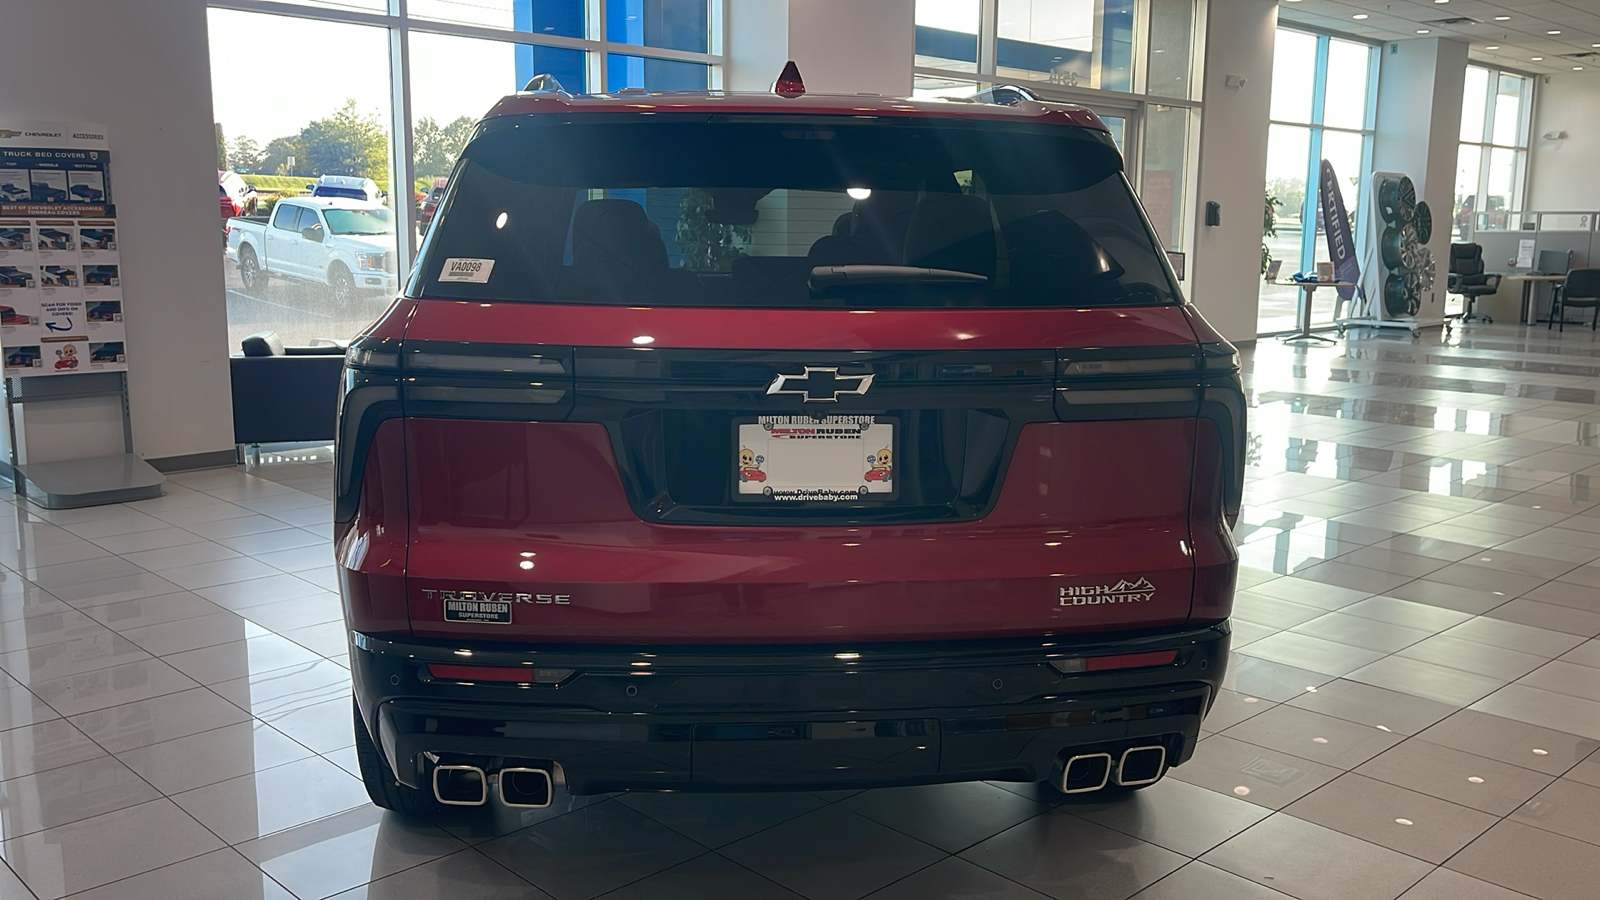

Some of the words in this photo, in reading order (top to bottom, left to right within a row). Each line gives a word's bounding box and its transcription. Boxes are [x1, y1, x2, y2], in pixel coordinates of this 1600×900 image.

[72, 132, 104, 141] ACCESSORIES
[1326, 168, 1347, 260] CERTIFIED
[451, 261, 483, 273] VA0098
[758, 415, 790, 425] MILTON
[821, 415, 876, 425] SUPERSTORE
[774, 493, 858, 502] www.drivebaby.com
[1060, 585, 1110, 596] HIGH
[422, 588, 571, 605] TRAVERSE
[1060, 592, 1155, 606] COUNTRY
[448, 601, 478, 612] MILTON
[479, 602, 508, 613] RUBEN
[458, 612, 499, 620] SUPERSTORE
